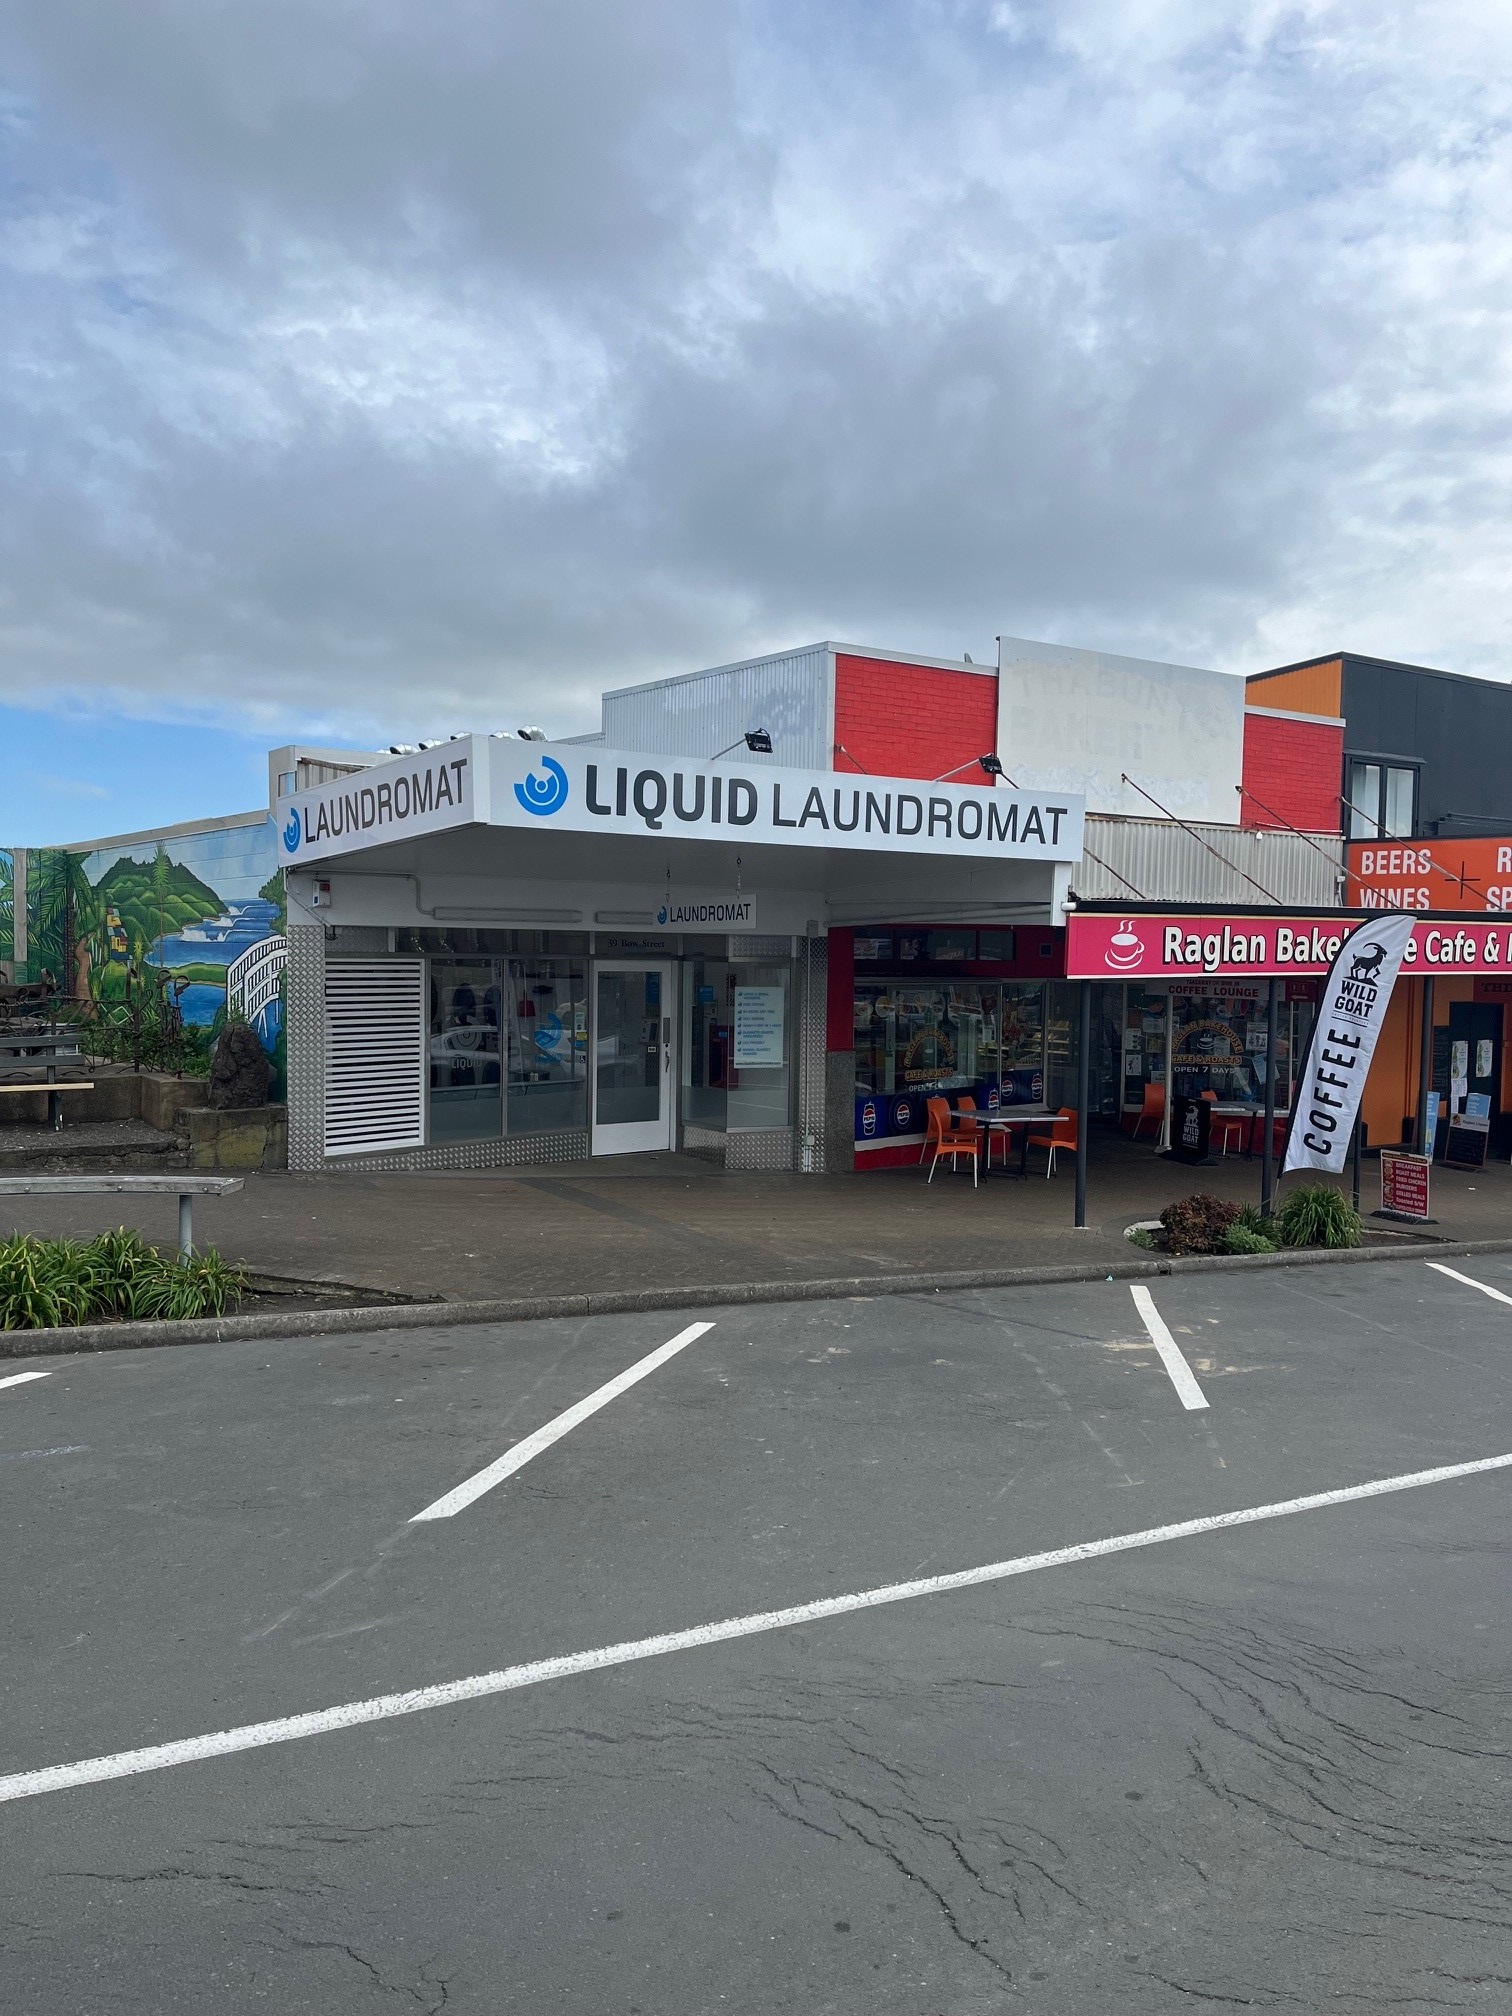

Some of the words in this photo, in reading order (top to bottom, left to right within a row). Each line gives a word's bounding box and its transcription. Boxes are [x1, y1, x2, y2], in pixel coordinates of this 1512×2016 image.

[305, 758, 468, 844] LAUNDROMAT
[585, 764, 758, 830] LIQUID
[772, 783, 1068, 845] LAUNDROMAT
[1361, 849, 1431, 875] BEERS
[1360, 887, 1430, 911] WINES
[670, 903, 751, 923] LAUNDROMAT
[608, 938, 618, 948] 39
[621, 938, 639, 948] Bow
[642, 938, 665, 948] Street
[1164, 925, 1267, 972] Raglan
[1425, 929, 1477, 963] Cafe
[1483, 931, 1501, 964] &
[1168, 985, 1208, 995] COFFEE
[1213, 987, 1259, 998] LOUNGE
[1341, 980, 1378, 1003] WILD
[1334, 995, 1374, 1018] GOAT
[1172, 1056, 1194, 1064] CAFE
[1205, 1056, 1241, 1065] ROASTS
[905, 1070, 923, 1081] CAFE
[1174, 1066, 1199, 1074] OPEN
[1202, 1066, 1209, 1074] 7
[1212, 1067, 1236, 1075] DAYS
[909, 1084, 926, 1092] OPEN
[1303, 1028, 1361, 1156] COFFEE
[1183, 1125, 1199, 1136] WILD
[1182, 1134, 1199, 1144] GOAT
[1395, 1162, 1422, 1172] BREAKFAST
[1410, 1171, 1425, 1179] MEALS
[1395, 1183, 1418, 1192] BURGERS
[1408, 1178, 1427, 1187] CHICKEN
